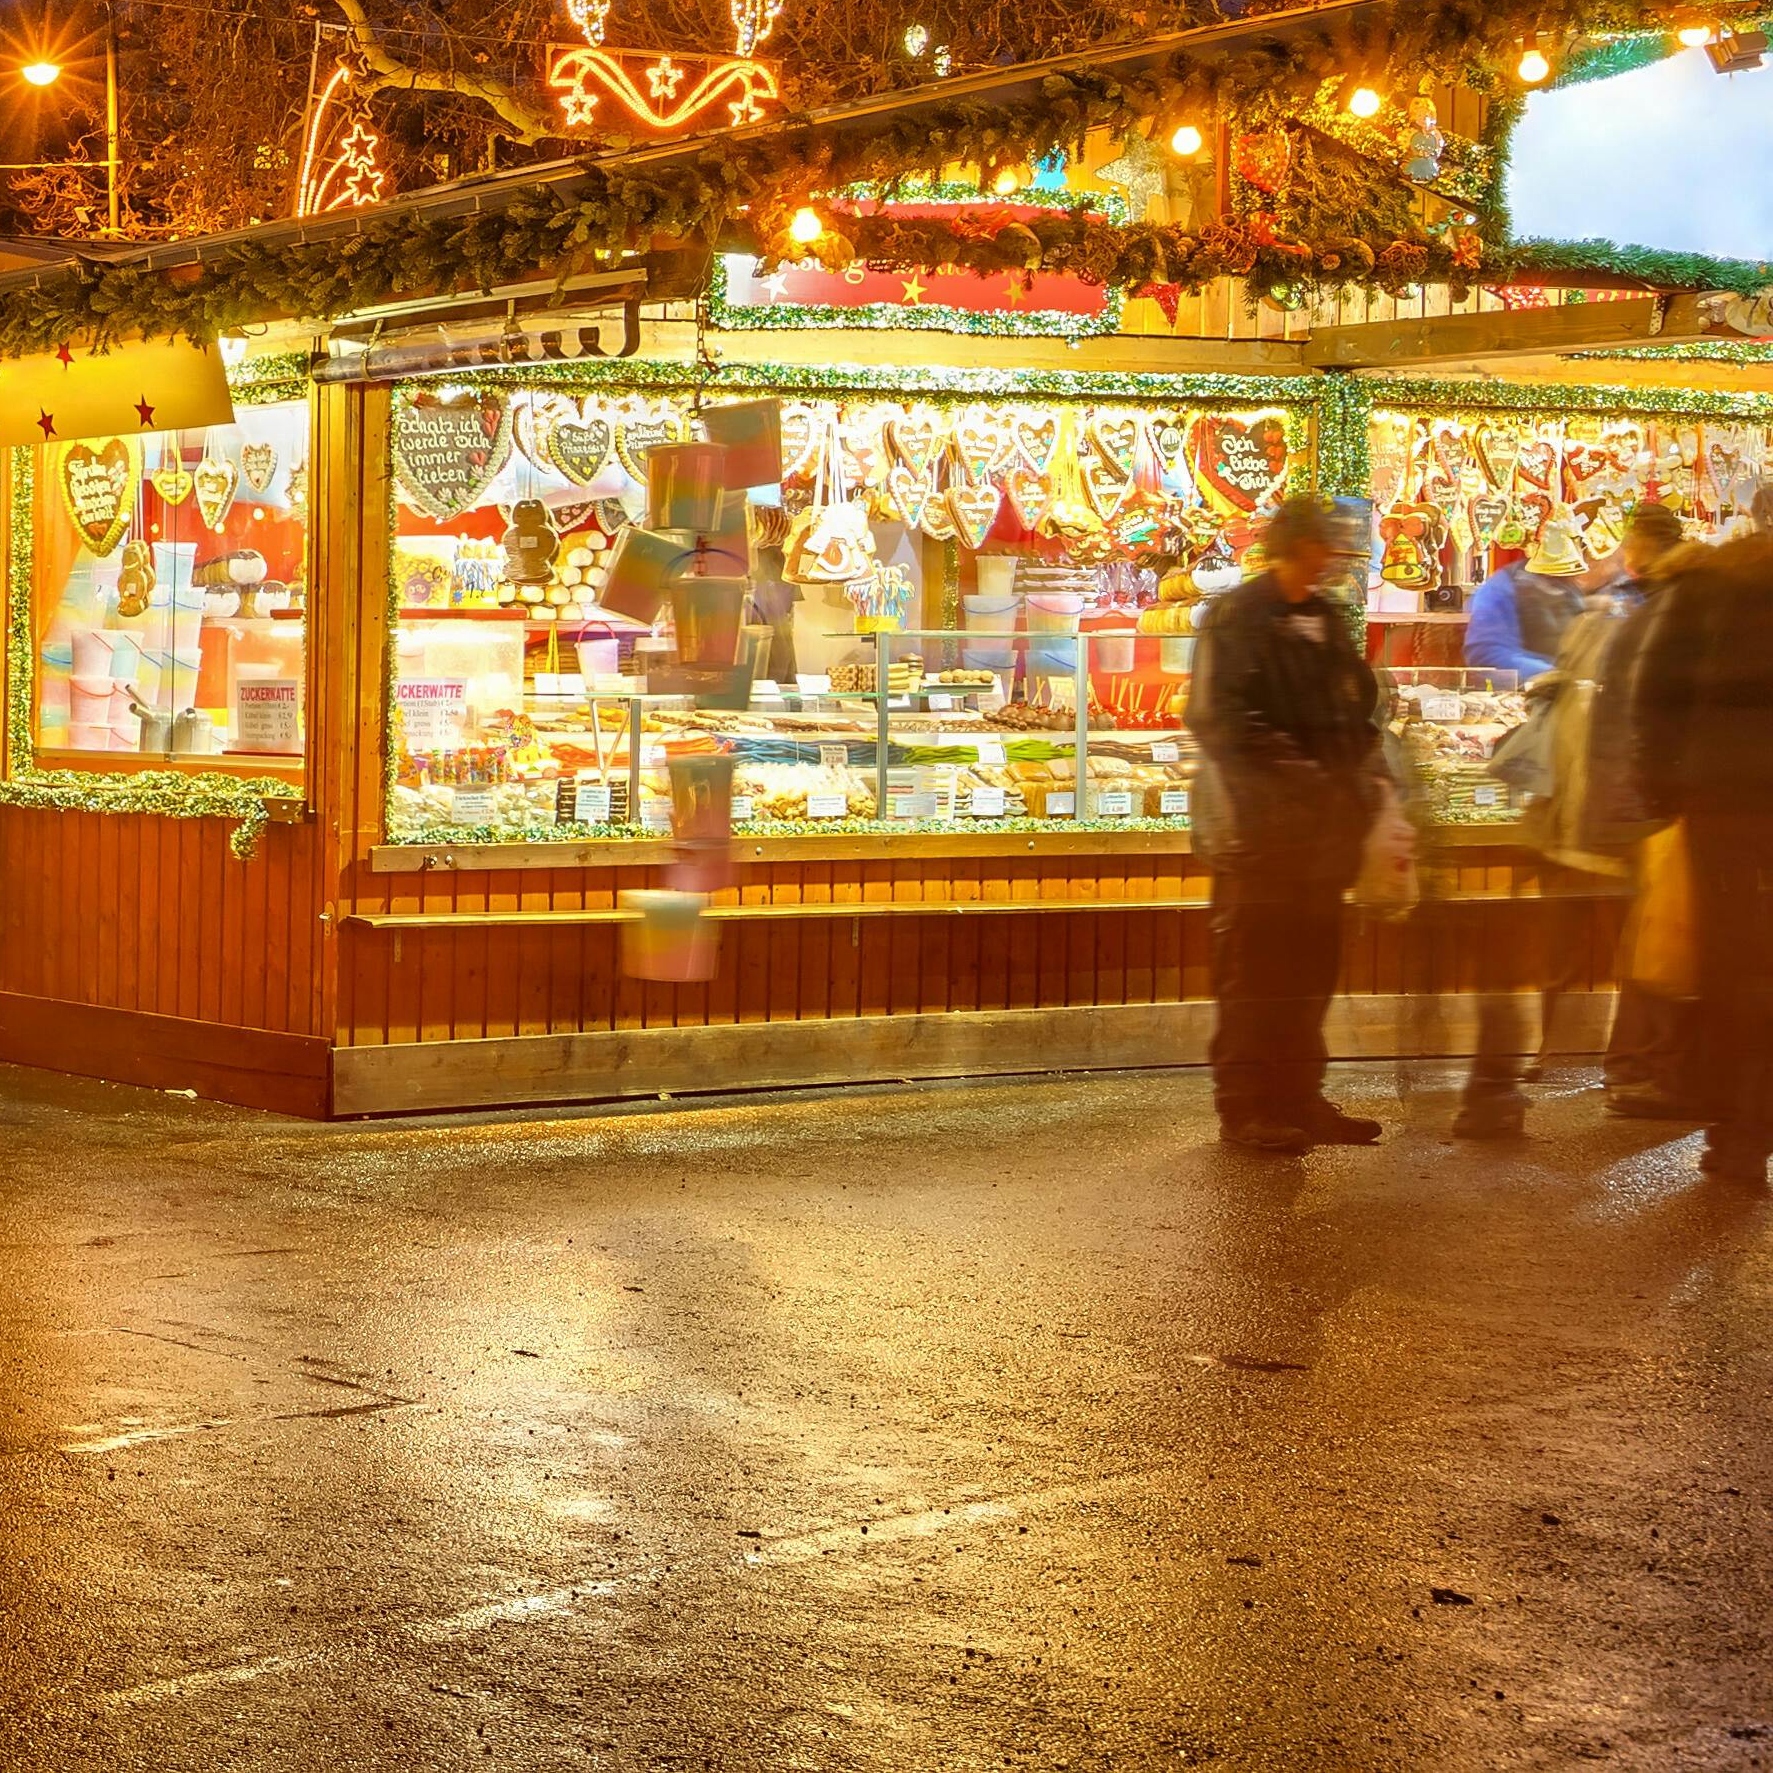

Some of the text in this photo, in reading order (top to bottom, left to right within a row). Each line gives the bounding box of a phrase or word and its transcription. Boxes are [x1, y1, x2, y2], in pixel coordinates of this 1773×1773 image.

[399, 434, 450, 451] werde
[1221, 434, 1260, 455] Ich
[408, 450, 462, 467] immer
[1229, 454, 1270, 472] liebe
[415, 466, 469, 484] lieben
